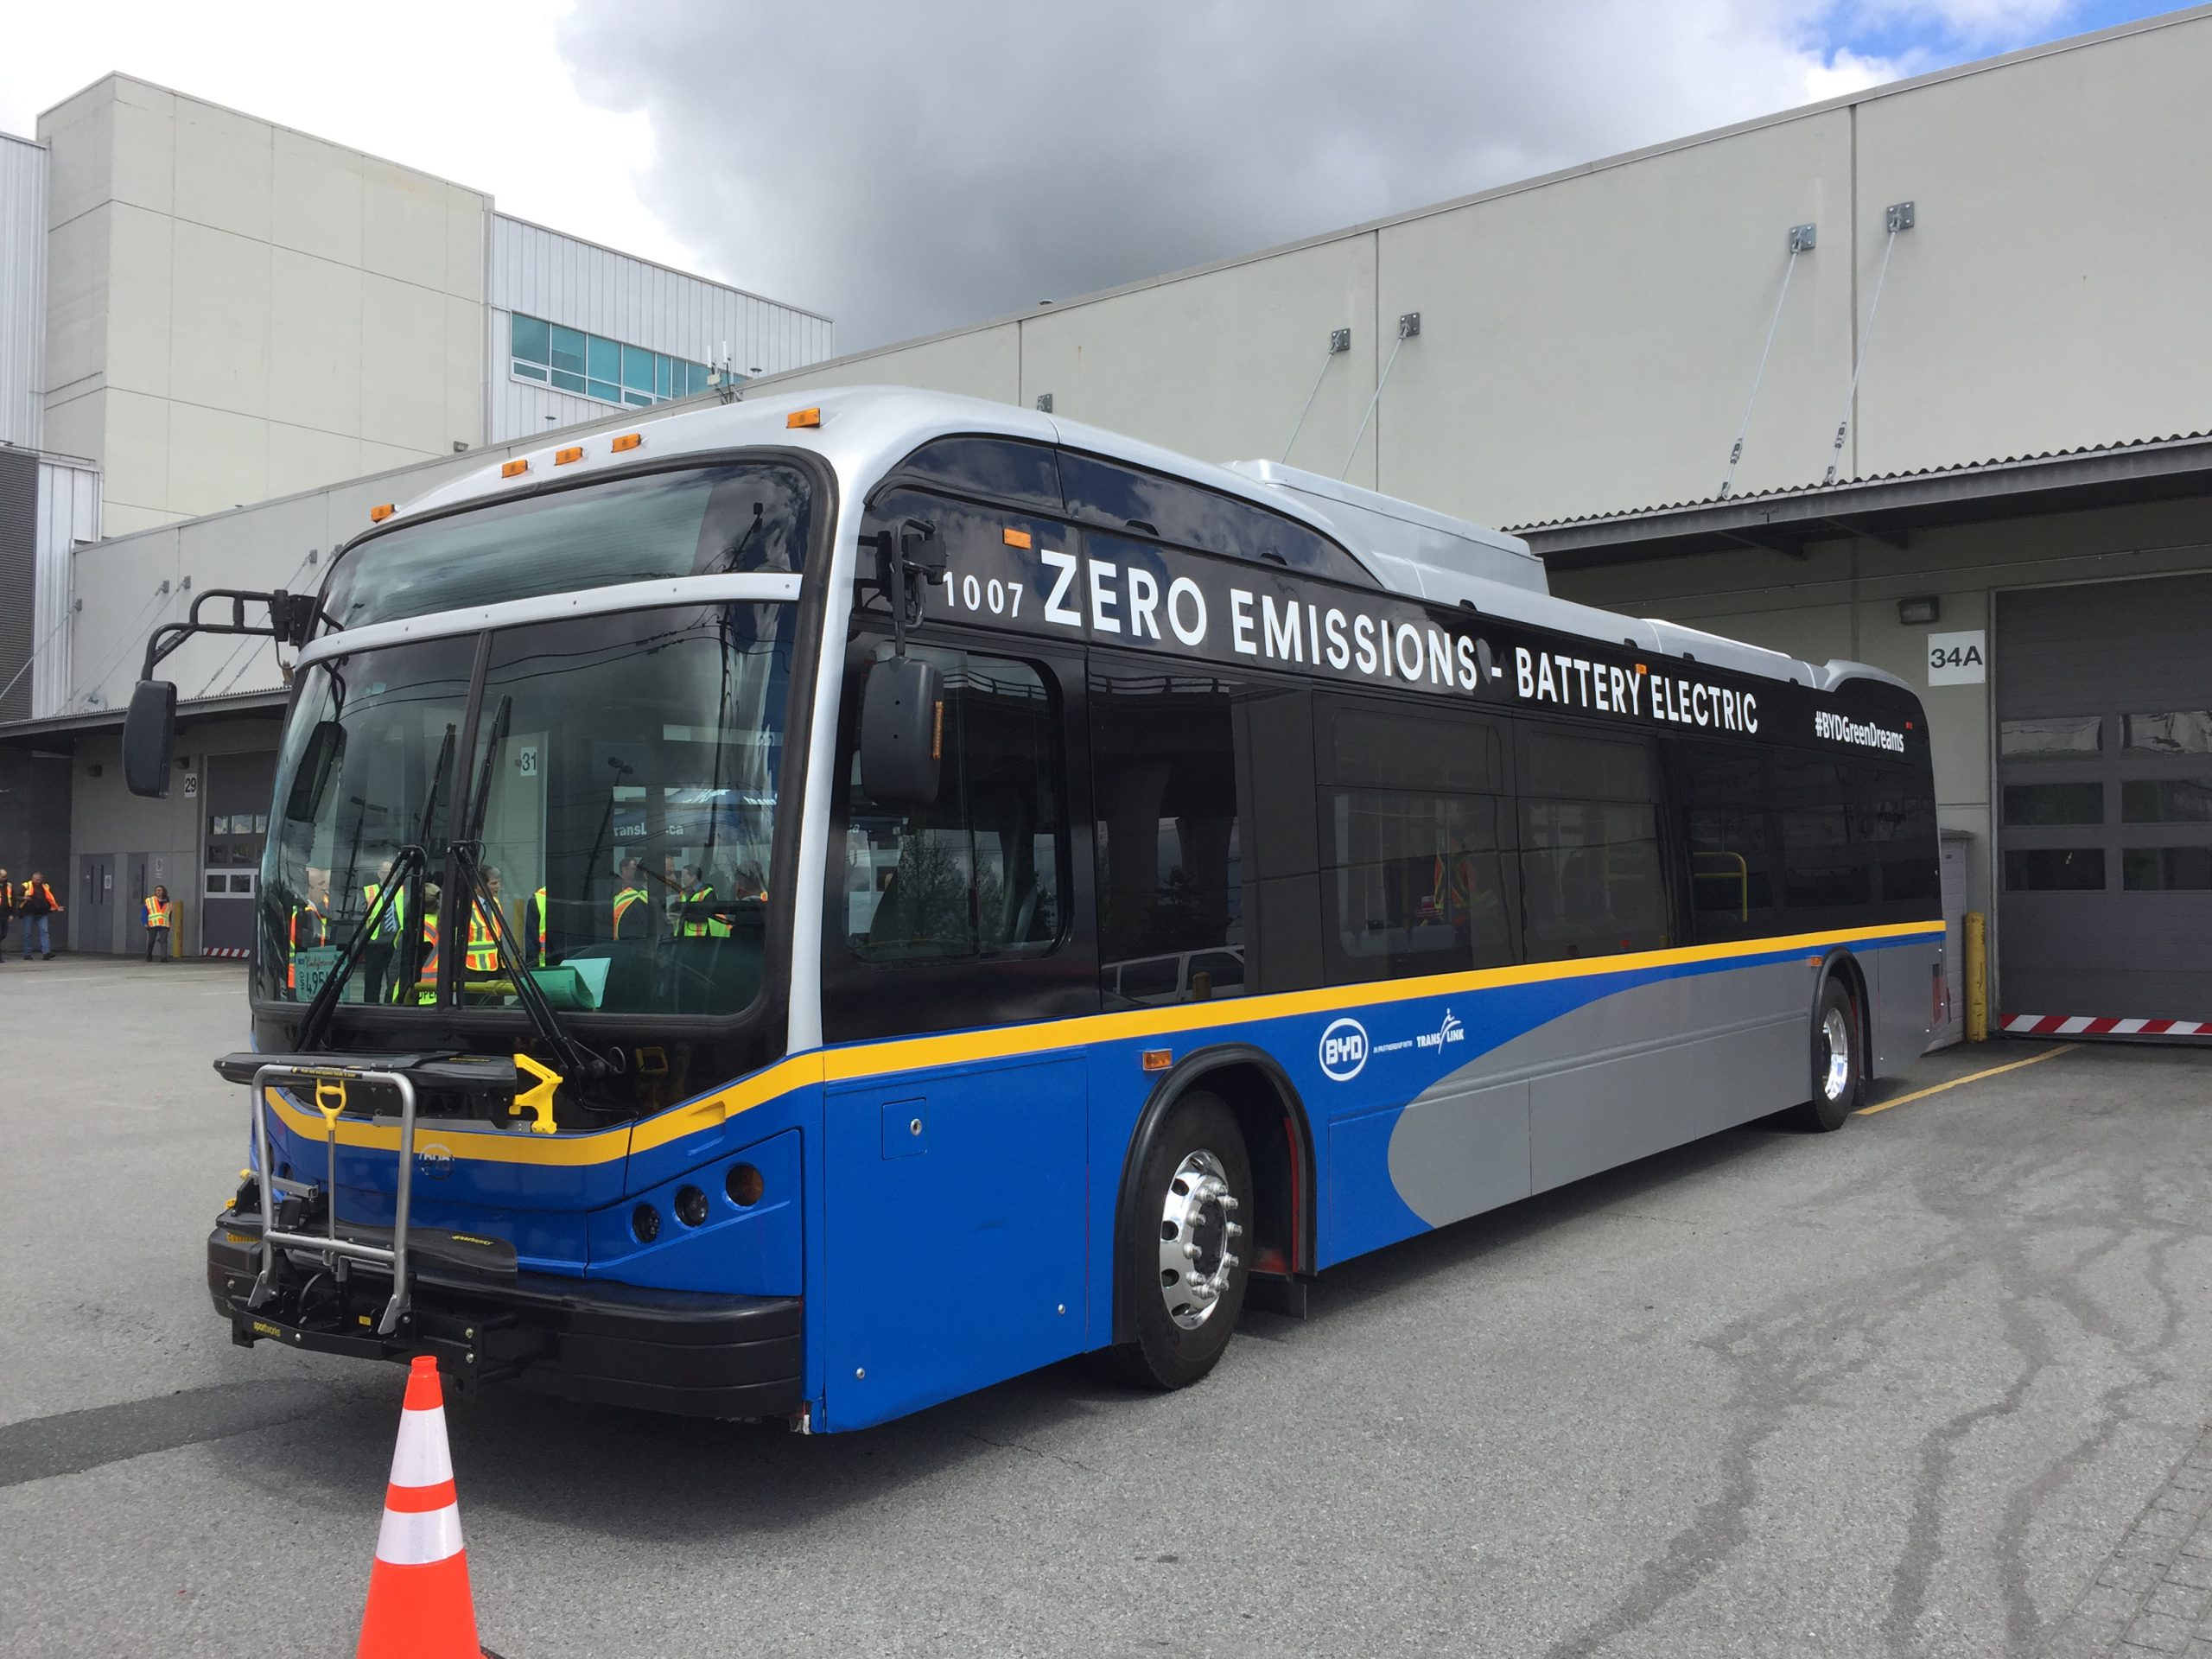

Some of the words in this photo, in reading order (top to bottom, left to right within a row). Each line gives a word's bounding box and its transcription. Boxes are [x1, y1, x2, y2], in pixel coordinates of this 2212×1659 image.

[944, 571, 1023, 618] 1007
[1040, 549, 1207, 646] ZERO
[1230, 588, 1477, 690] EMISSIONS
[1516, 646, 1641, 715] BATTERY
[1650, 675, 1758, 734] ELECTRIC
[1930, 645, 1983, 668] 34A
[1815, 710, 1904, 753] #BYDGreenDreams
[522, 752, 537, 771] 31
[185, 778, 196, 792] 29
[1325, 1035, 1363, 1065] BYD
